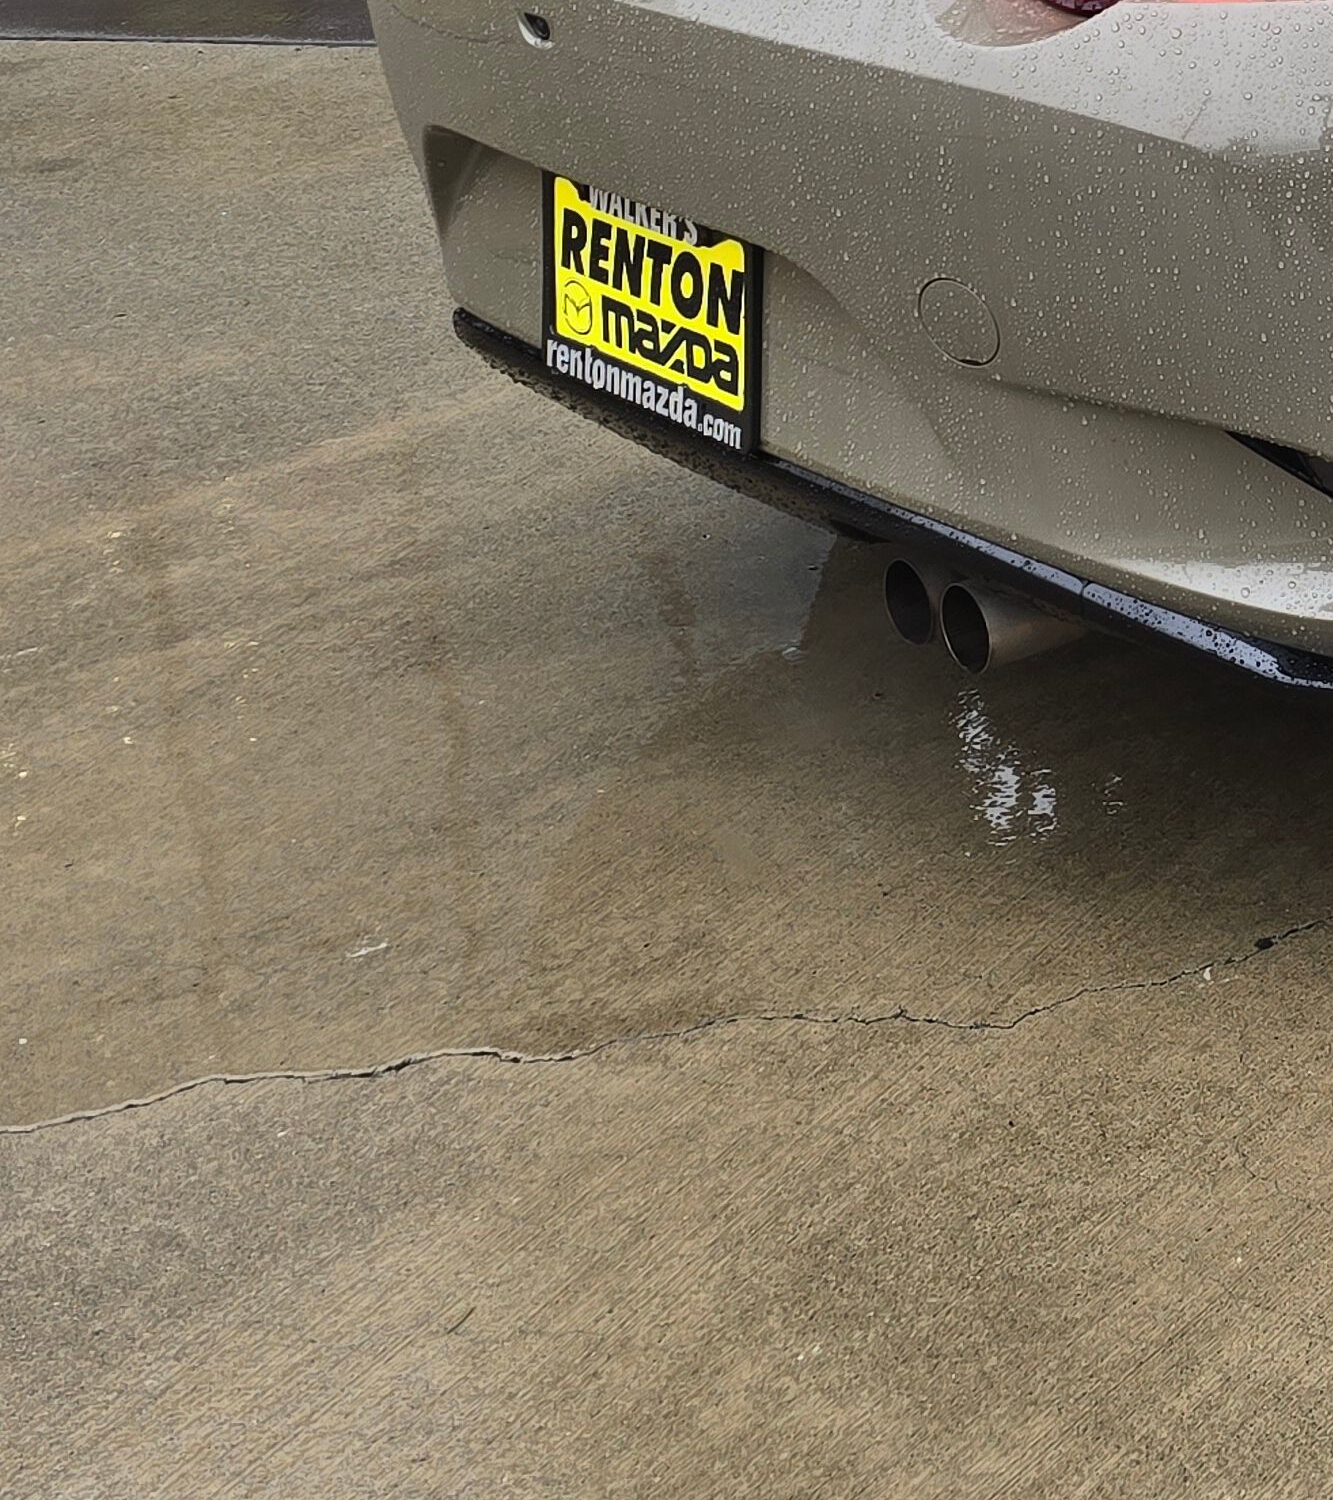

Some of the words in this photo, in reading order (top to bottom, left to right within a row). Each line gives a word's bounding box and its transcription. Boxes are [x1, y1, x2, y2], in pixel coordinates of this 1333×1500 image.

[589, 185, 698, 246] WALKER'S
[561, 207, 746, 335] RENTON
[546, 338, 742, 450] rentonmazda.com
[601, 294, 739, 397] mazda
